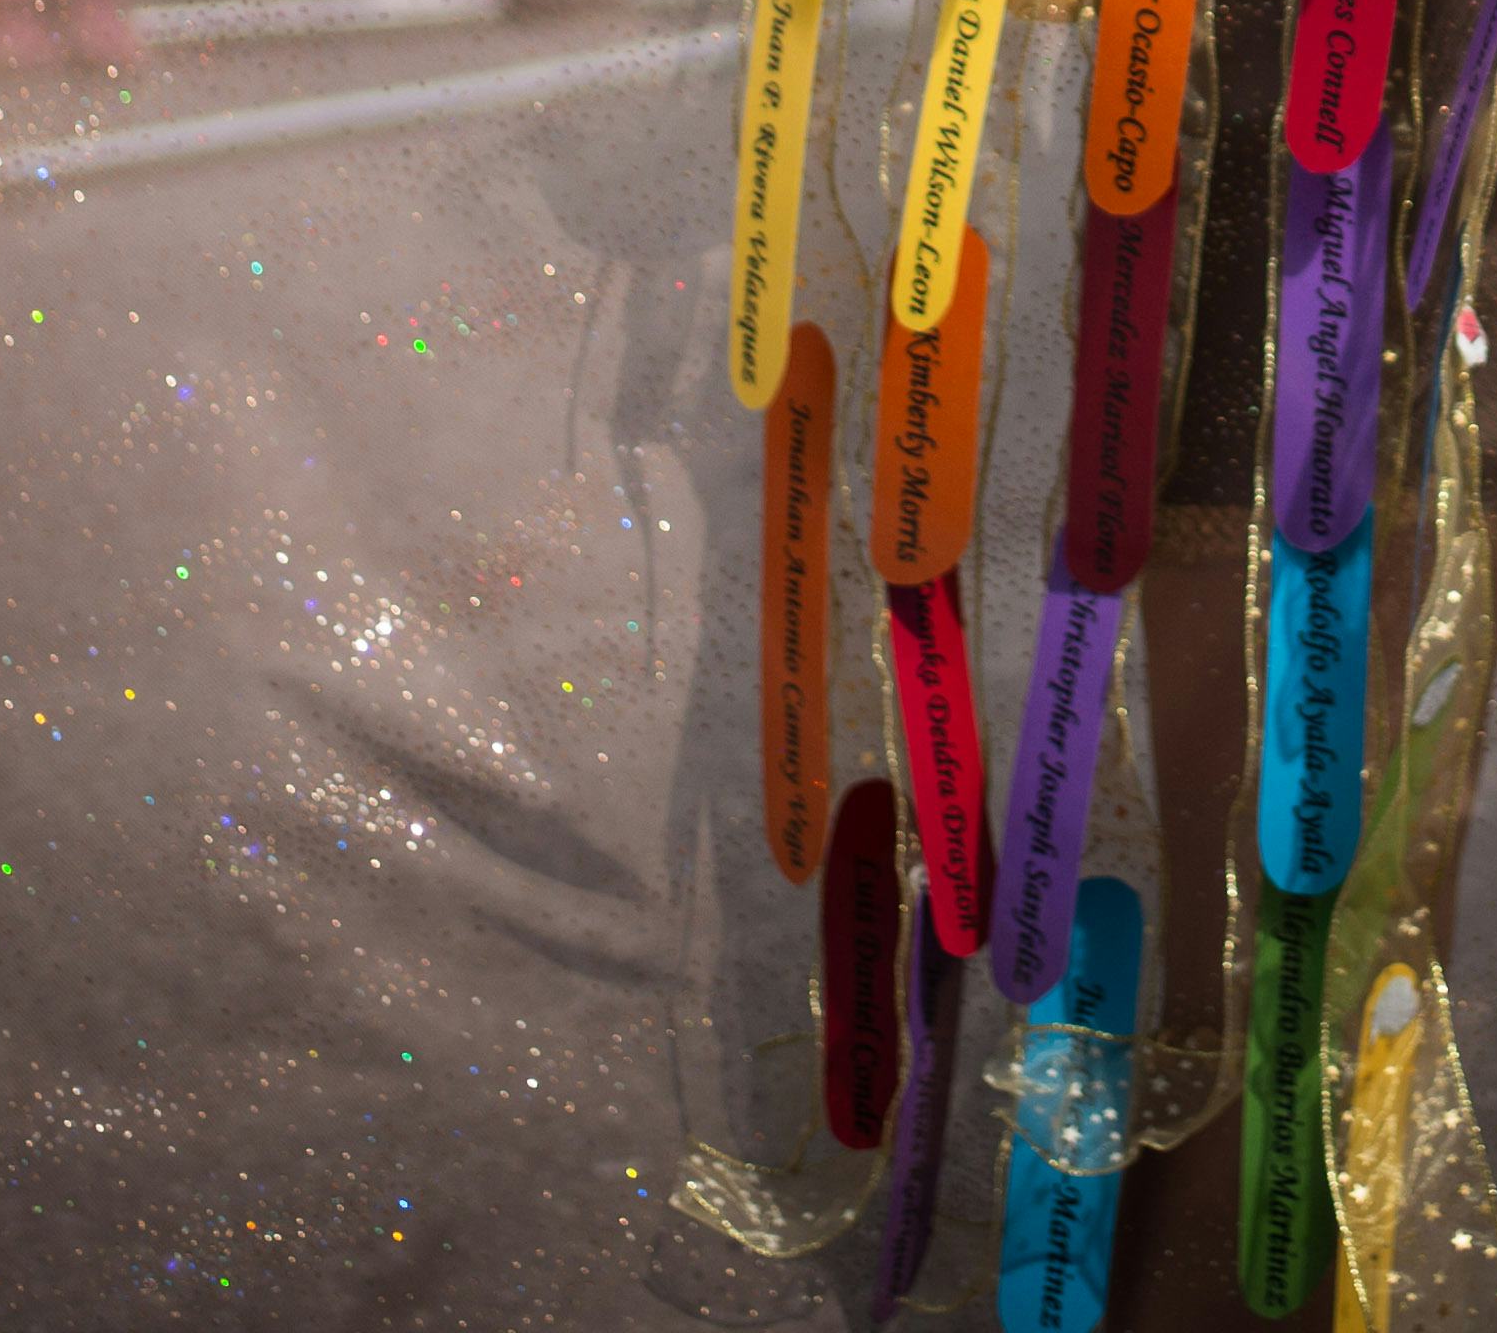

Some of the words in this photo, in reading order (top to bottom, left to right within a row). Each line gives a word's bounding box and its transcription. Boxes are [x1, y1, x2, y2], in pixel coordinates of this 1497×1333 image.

[762, 81, 780, 108] P.
[942, 10, 980, 115] Daniel
[1106, 8, 1161, 193] Ocasio-Capo
[1315, 29, 1355, 154] Connell
[750, 123, 775, 219] Rivera
[909, 123, 960, 315] Wilson-Leon
[1314, 175, 1355, 289] Miguel
[736, 231, 767, 383] Velazquez
[1108, 219, 1142, 358] Mercedez
[1308, 288, 1353, 386] Angel
[895, 327, 939, 458] Kimberly
[1099, 368, 1130, 488] Marisol
[787, 399, 810, 540] Jonathan
[898, 465, 929, 561] Morris
[1309, 388, 1347, 536] Honorato
[1095, 488, 1126, 575] Flores
[783, 545, 805, 673] Antonio
[1298, 548, 1345, 671] Rodolfo
[780, 681, 804, 786] Camuy
[926, 694, 961, 796] Deidra
[1296, 678, 1337, 874] Ayala-Ayala
[785, 794, 808, 868] Vega
[1025, 752, 1065, 857] Joseph
[941, 804, 980, 932] Drayton
[1011, 859, 1050, 983] Sanfeliz
[1271, 1041, 1306, 1156] Barrios
[1257, 1164, 1300, 1306] Martinez
